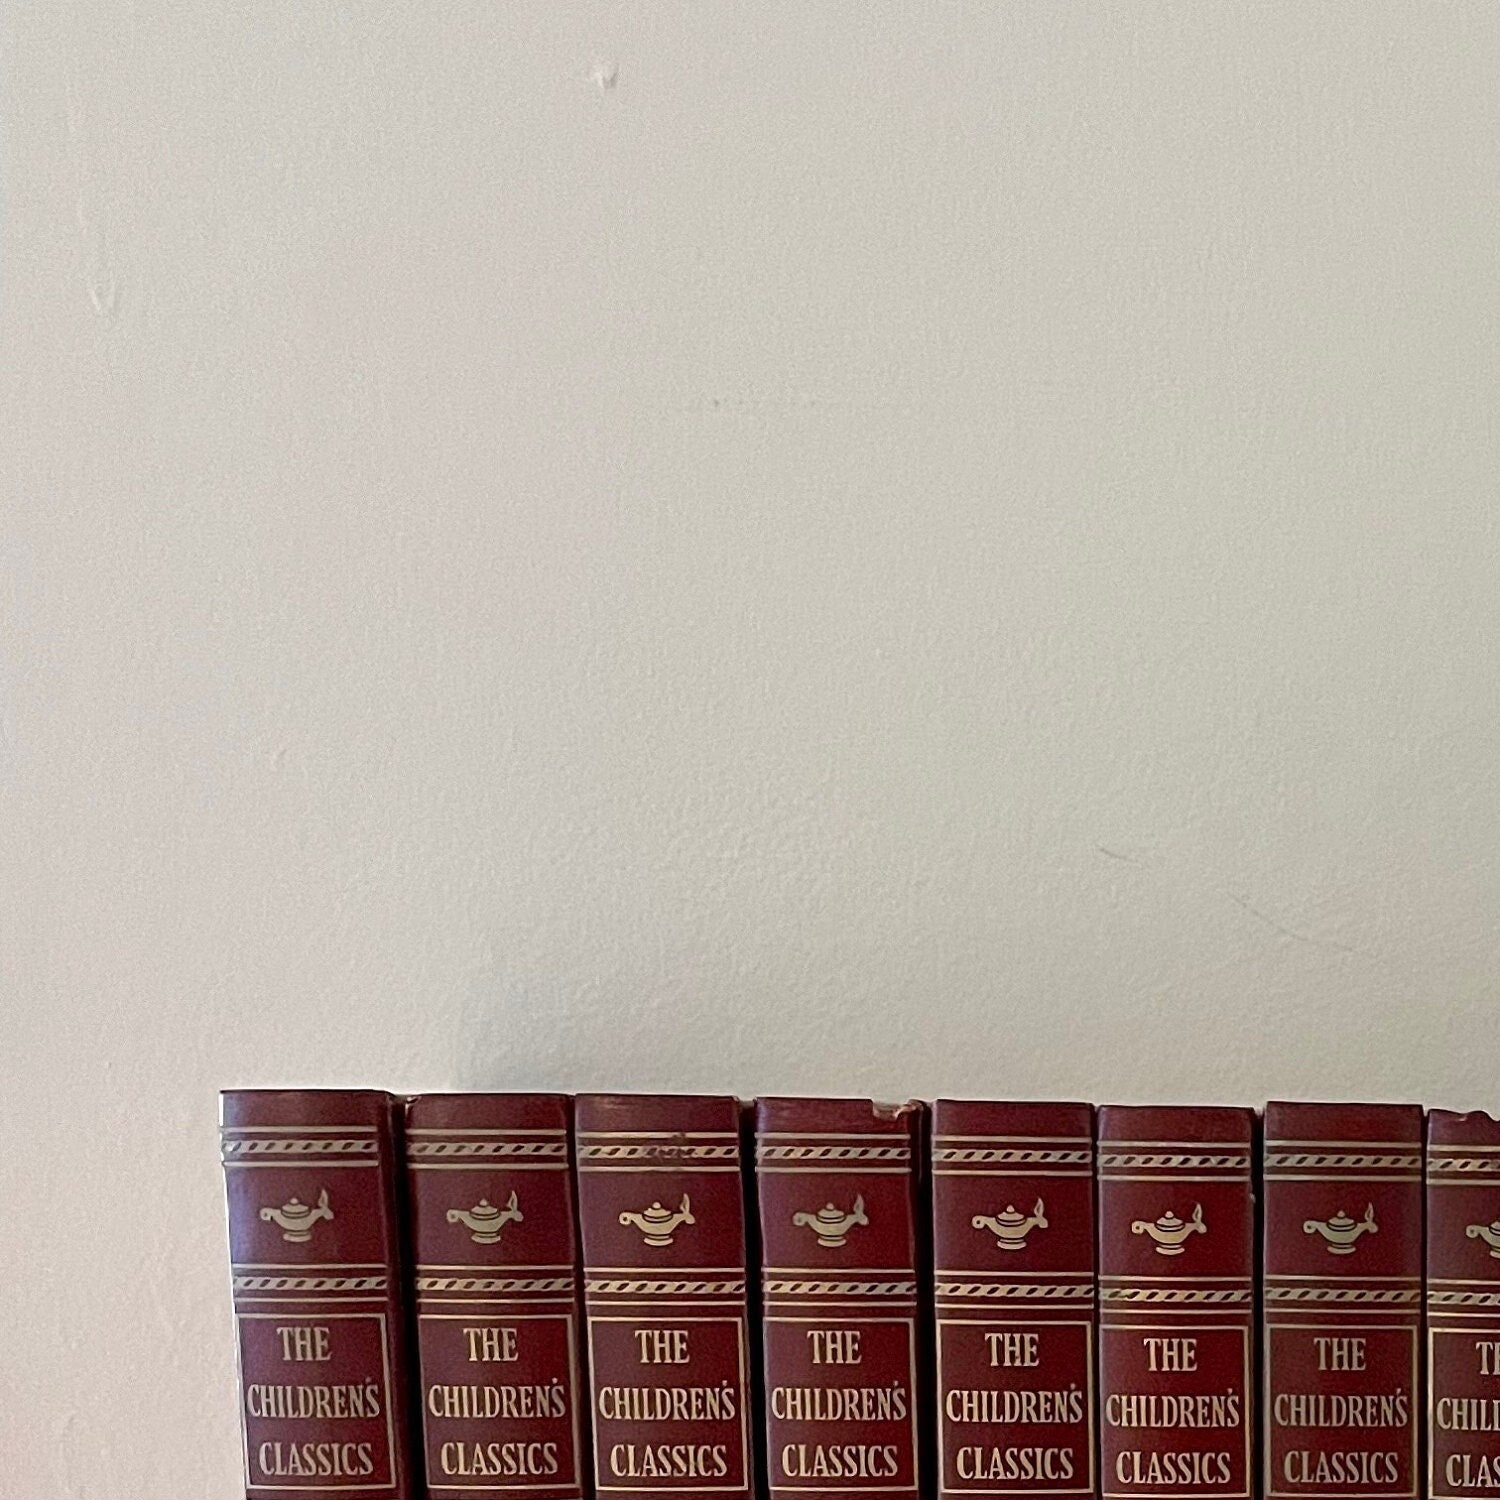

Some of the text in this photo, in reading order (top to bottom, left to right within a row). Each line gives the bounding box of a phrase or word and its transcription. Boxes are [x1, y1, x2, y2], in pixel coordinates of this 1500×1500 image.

[276, 1327, 330, 1361] THE
[463, 1328, 518, 1361] THE
[635, 1330, 689, 1363] THE
[807, 1331, 861, 1363] THE
[985, 1333, 1039, 1366] THE
[1144, 1338, 1197, 1371] THE
[1314, 1338, 1365, 1370] THE
[247, 1377, 379, 1418] CHILDREN'S
[429, 1378, 565, 1418] CHILDREN'S
[599, 1380, 735, 1420] CHILDREN'S
[771, 1381, 906, 1420] CHILDREN'S
[946, 1384, 1082, 1423] CHILDREN'S
[1106, 1389, 1239, 1427] CHILDREN'S
[1275, 1389, 1407, 1426] CHILDREN'S
[259, 1442, 373, 1476] CLASSICS
[441, 1442, 557, 1475] CLASSICS
[611, 1444, 727, 1477] CLASSICS
[782, 1444, 897, 1477] CLASSICS
[957, 1447, 1073, 1479] CLASSICS
[1116, 1452, 1230, 1484] CLASSICS
[1285, 1451, 1397, 1483] CLASSICS
